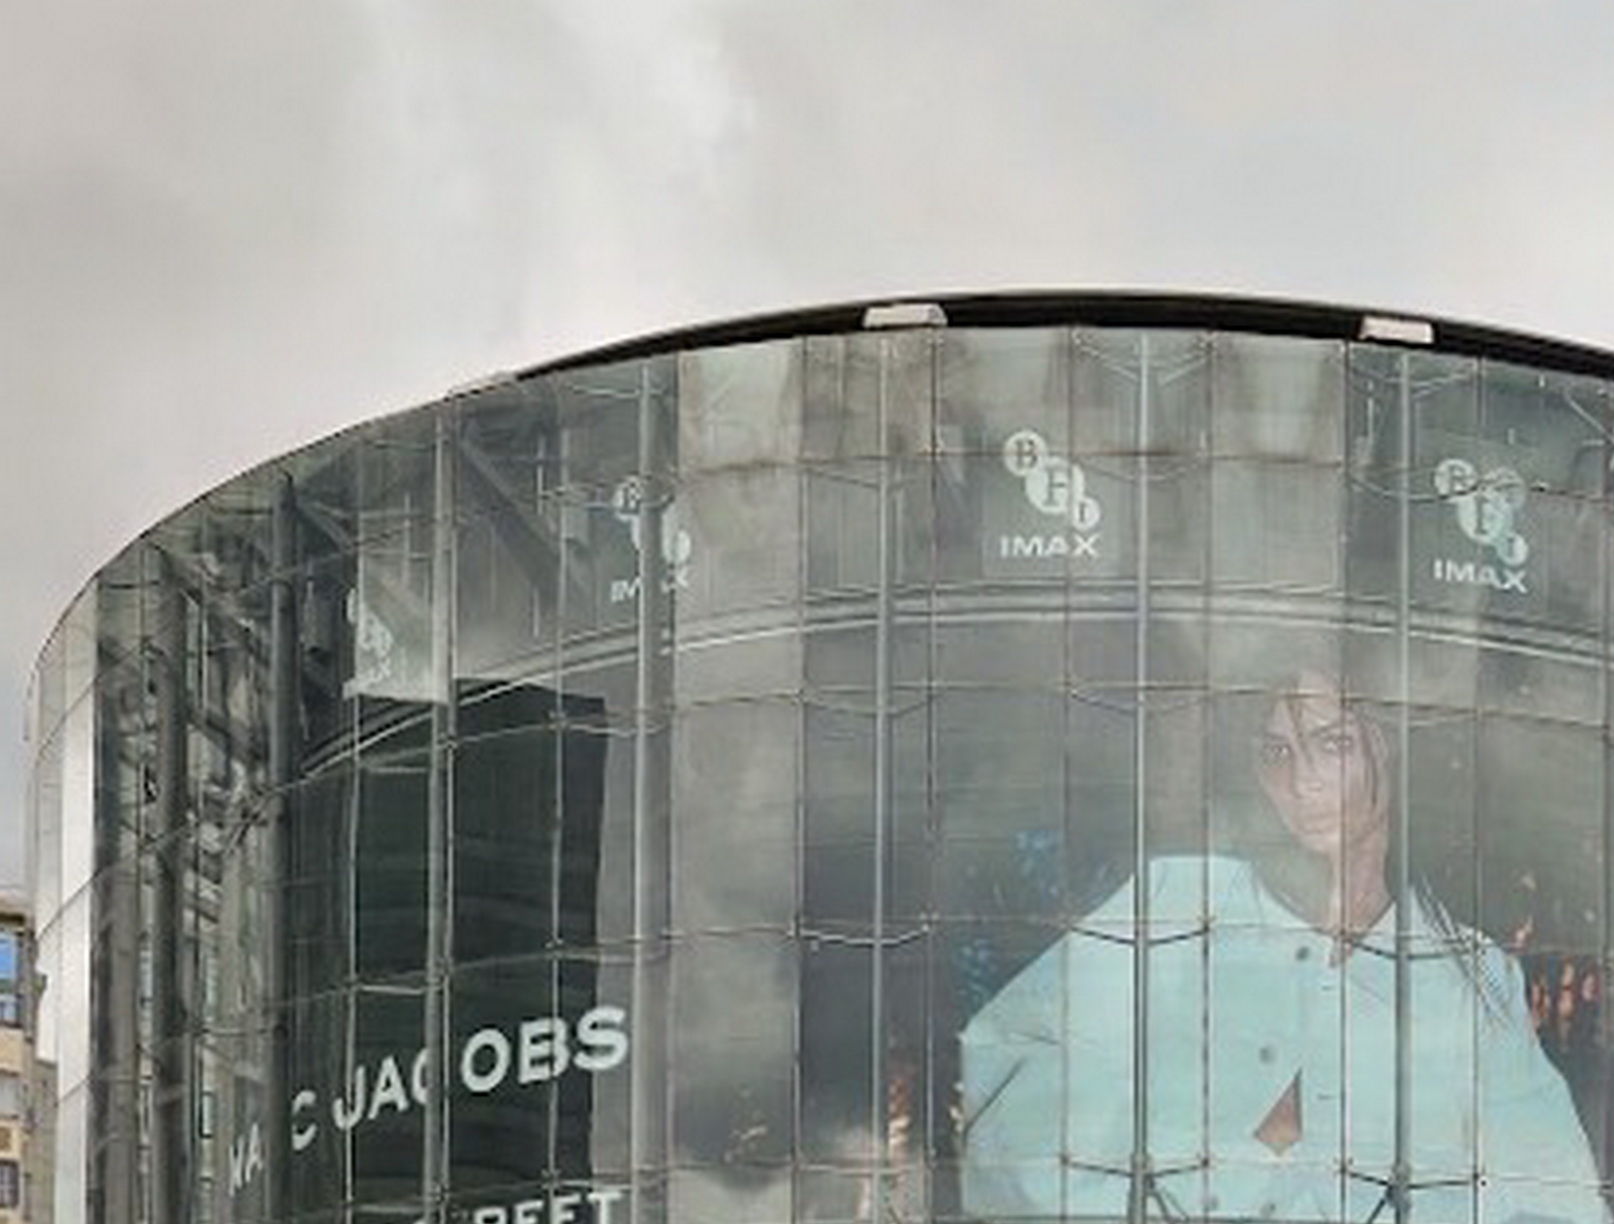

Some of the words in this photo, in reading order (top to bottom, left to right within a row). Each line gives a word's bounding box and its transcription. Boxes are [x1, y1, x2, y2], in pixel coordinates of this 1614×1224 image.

[1001, 533, 1101, 558] IMAX
[611, 566, 689, 602] IMX
[1434, 559, 1528, 594] IMAX
